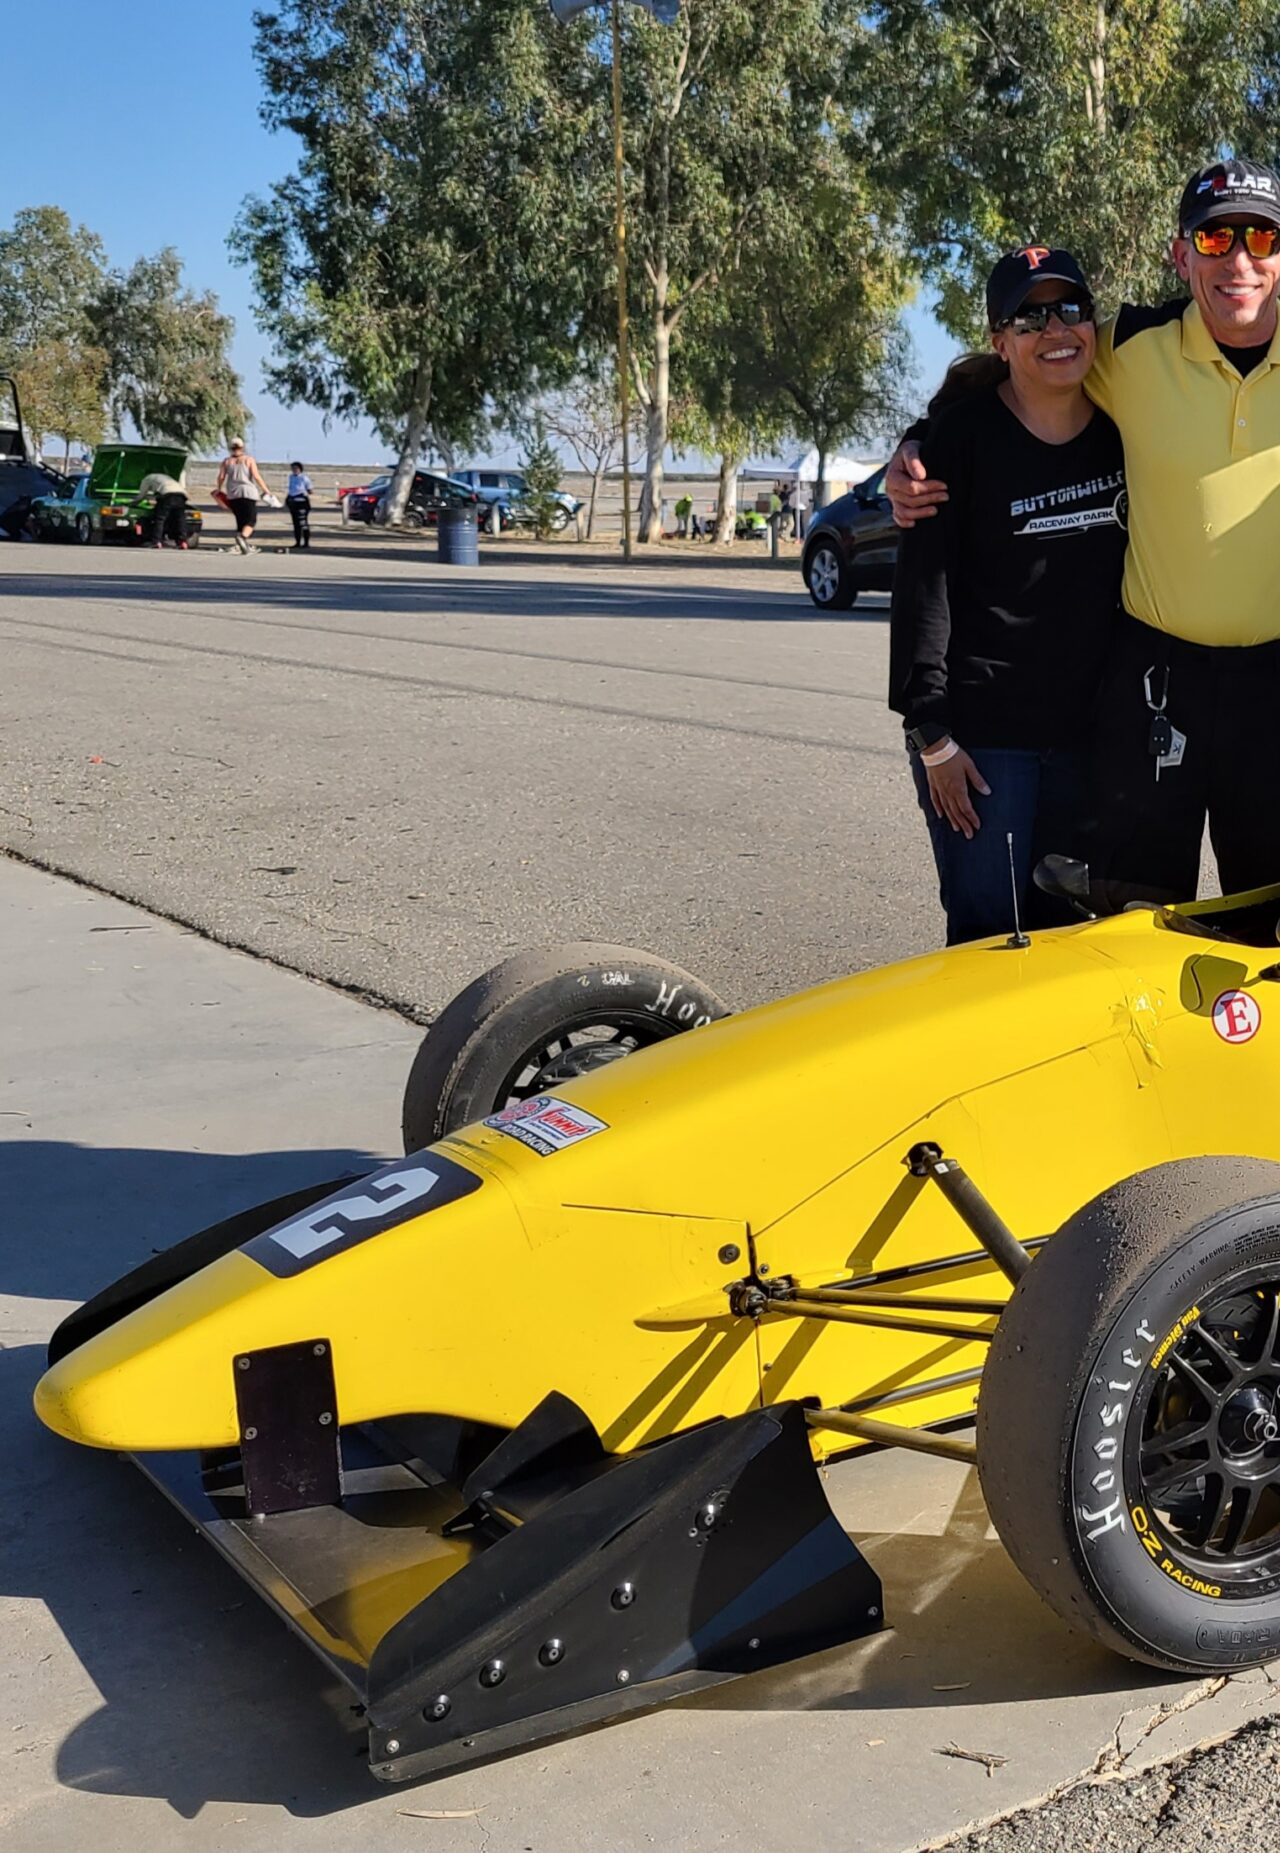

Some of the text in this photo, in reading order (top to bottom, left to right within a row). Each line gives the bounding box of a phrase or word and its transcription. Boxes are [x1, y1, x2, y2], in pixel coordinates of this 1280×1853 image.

[1029, 509, 1114, 531] RACEWAY PARK
[1220, 996, 1252, 1037] E
[521, 1132, 556, 1156] RACING
[269, 1167, 440, 1260] 2
[1151, 1305, 1201, 1370] Van Diemen
[1078, 1319, 1156, 1543] Hoosier
[1161, 1558, 1222, 1598] RACING
